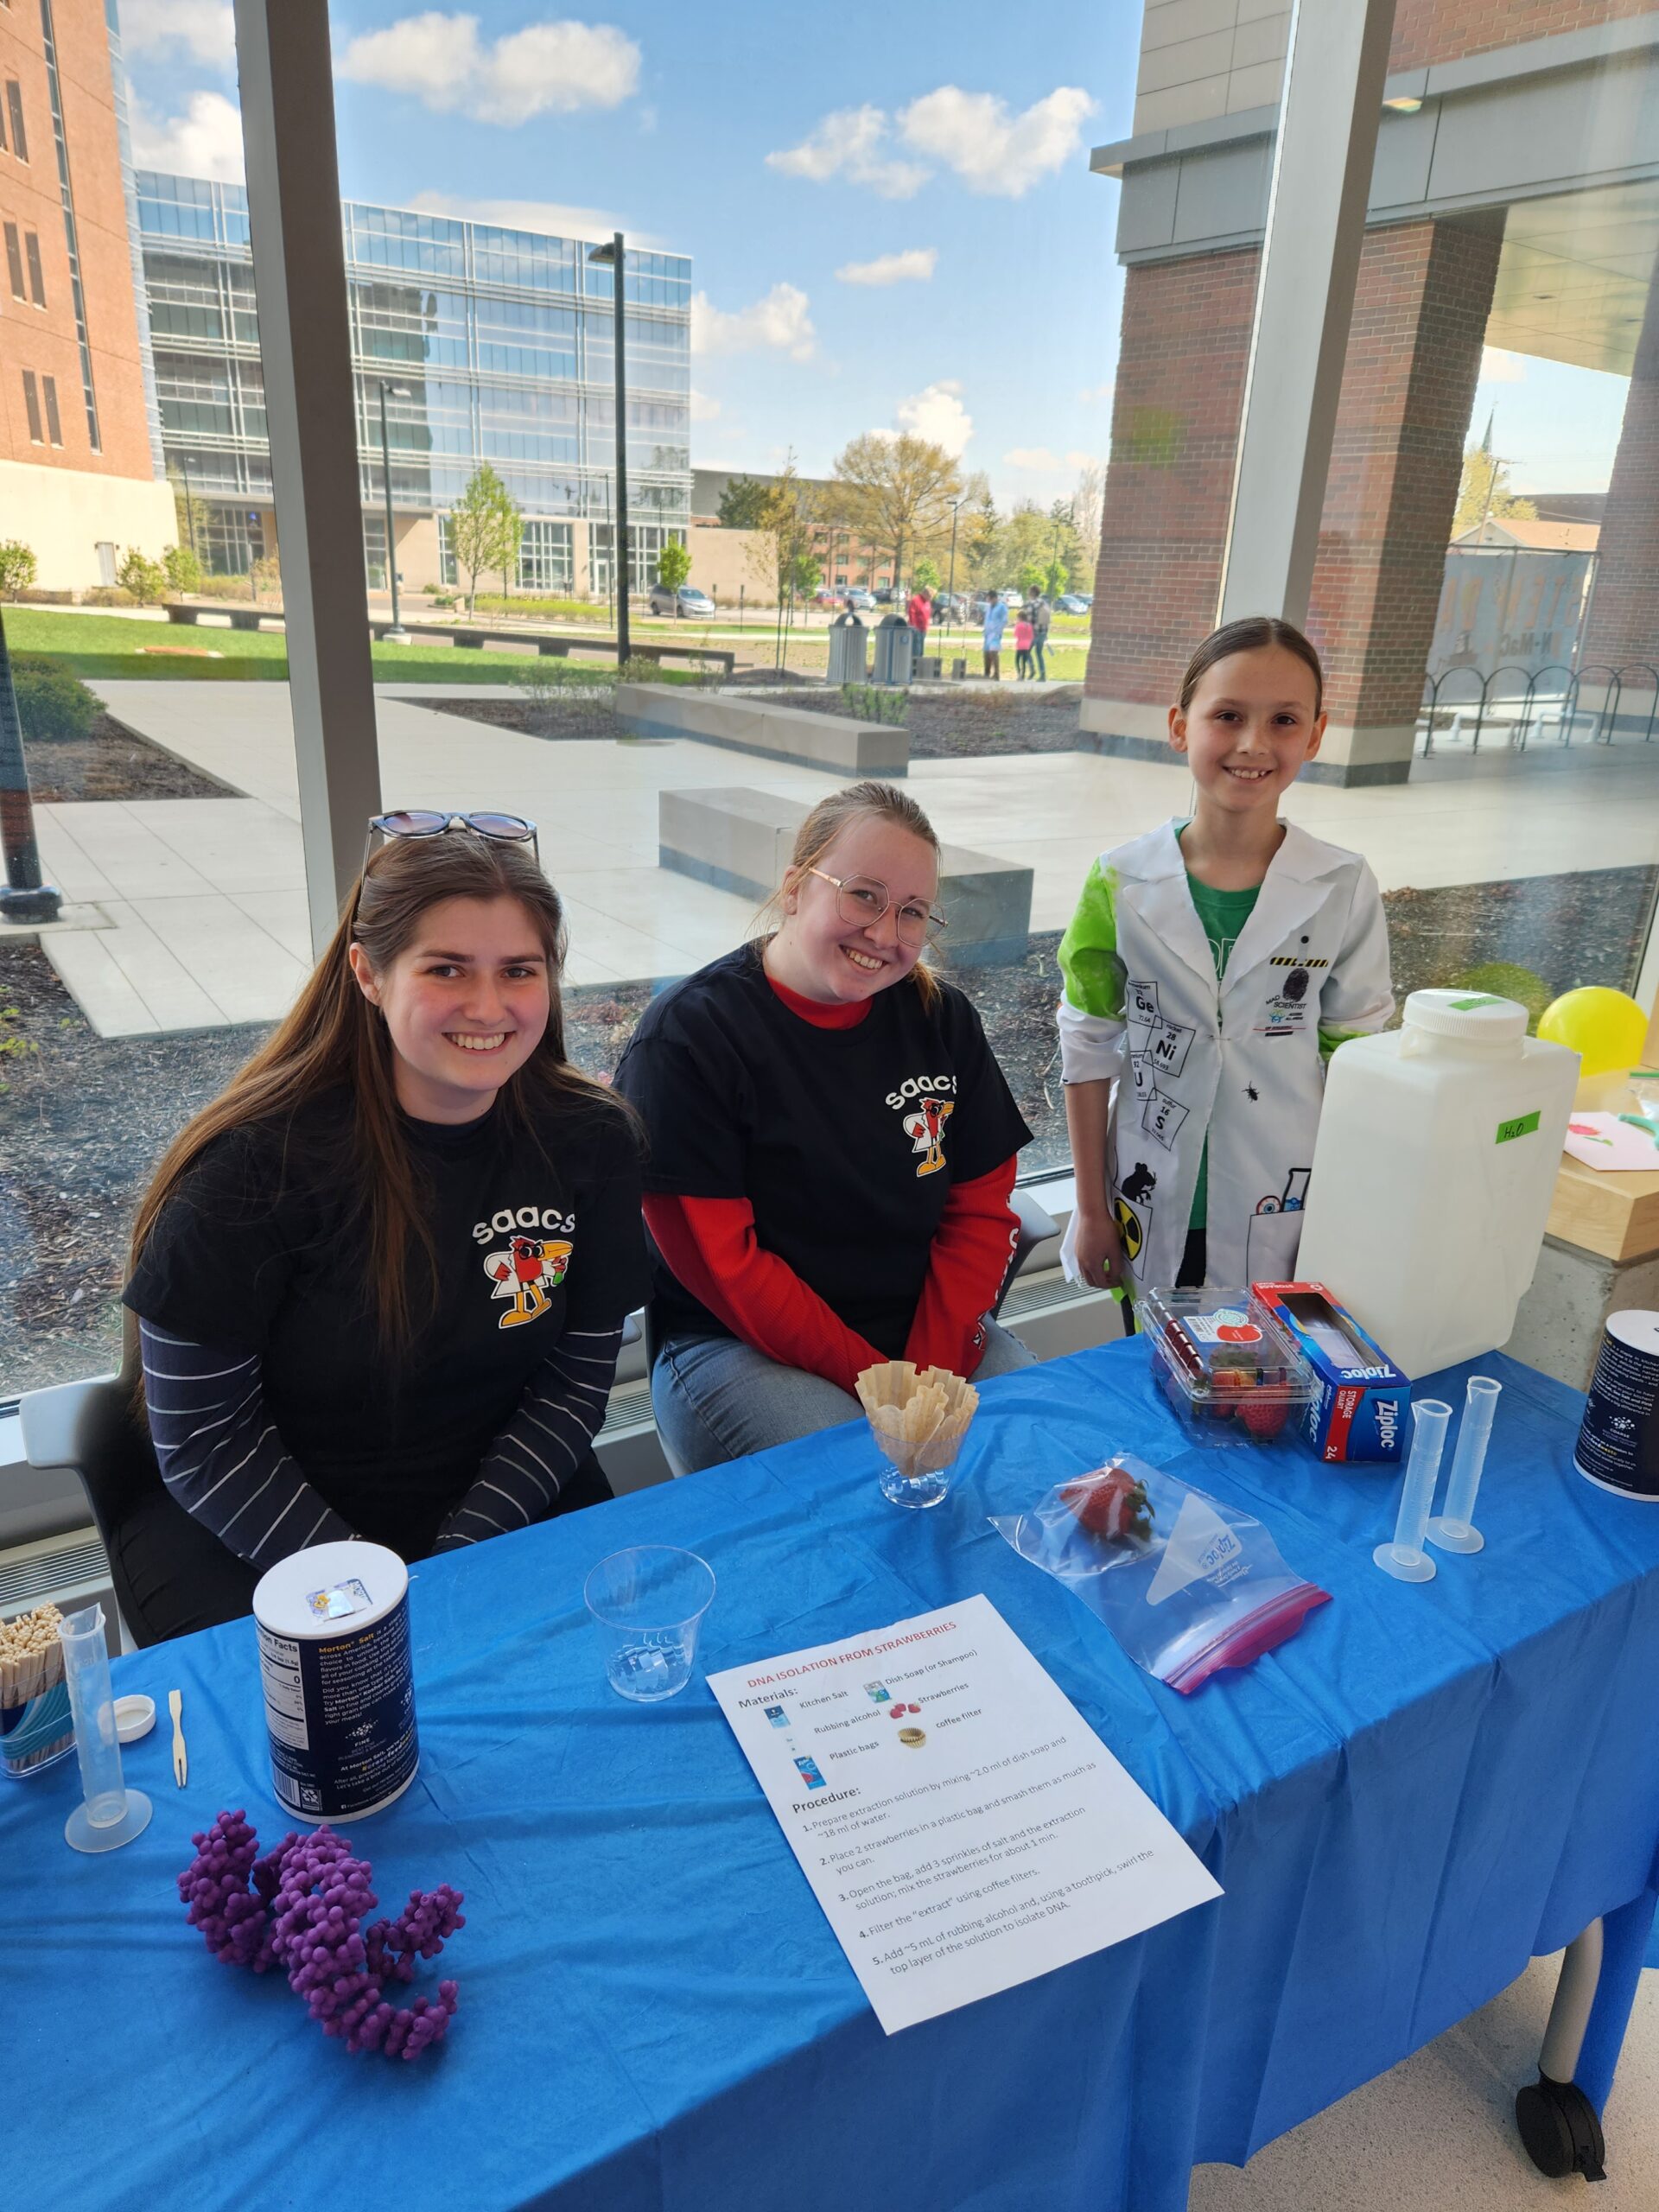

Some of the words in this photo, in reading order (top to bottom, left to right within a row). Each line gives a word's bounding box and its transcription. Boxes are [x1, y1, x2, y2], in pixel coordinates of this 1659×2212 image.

[1135, 996, 1154, 1013] Ge
[1266, 995, 1281, 1005] MAD
[1166, 1032, 1177, 1041] 28
[1155, 1039, 1177, 1060] Ni
[1134, 1071, 1143, 1087] U
[1160, 1106, 1170, 1116] 16
[1155, 1116, 1166, 1130] S
[1341, 1364, 1396, 1379] Ziploc
[1337, 1390, 1346, 1409] QUART
[1342, 1390, 1357, 1419] STORAGE
[1309, 1395, 1322, 1443] ploc
[1375, 1400, 1399, 1449] Ziploc
[1325, 1446, 1338, 1459] 24
[274, 1638, 298, 1653] Facts
[359, 1632, 375, 1643] Salt
[747, 1675, 775, 1688] DNA
[775, 1657, 838, 1681] ISOLATION
[838, 1648, 874, 1664] FROM
[874, 1622, 957, 1654] STRAWBERRIES
[885, 1675, 904, 1685] Dish
[903, 1669, 925, 1680] Soap
[924, 1663, 937, 1673] (or
[937, 1649, 978, 1668] Shampoo)
[294, 1675, 301, 1684] 0
[738, 1688, 798, 1708] Materials:
[798, 1695, 832, 1709] Kitchen
[831, 1690, 849, 1700] Salt
[918, 1683, 969, 1704] Strawberries
[813, 1720, 851, 1734] Rubbing
[850, 1709, 881, 1725] alcohol
[936, 1717, 962, 1728] coffee
[961, 1708, 982, 1720] filter
[829, 1748, 858, 1761] Plastic
[857, 1741, 880, 1752] bags
[802, 1824, 813, 1833] 1.
[811, 1814, 849, 1829] Prepare
[849, 1798, 893, 1819] extraction
[893, 1786, 930, 1802] solution
[928, 1783, 941, 1791] by
[942, 1773, 971, 1787] mixing
[969, 1765, 989, 1777] ~2.0
[989, 1761, 1002, 1770] ml
[1001, 1757, 1012, 1767] of
[1012, 1751, 1030, 1763] dish
[1029, 1744, 1050, 1756] soap
[1050, 1736, 1067, 1748] and
[791, 1788, 861, 1814] Procedure:
[818, 1857, 830, 1866] 2.
[829, 1849, 855, 1863] Place
[855, 1846, 863, 1854] 2
[863, 1827, 920, 1852] strawberries
[918, 1823, 931, 1832] in
[938, 1811, 967, 1827] plastic
[964, 1806, 984, 1816] bag
[983, 1798, 1001, 1811] and
[1001, 1789, 1029, 1805] smash
[1027, 1781, 1052, 1795] them
[1051, 1777, 1063, 1785] as
[1062, 1766, 1086, 1781] much
[1085, 1762, 1096, 1770] as
[817, 1828, 836, 1839] ~18
[836, 1824, 849, 1834] ml
[850, 1820, 861, 1831] of
[860, 1812, 891, 1827] water.
[837, 1893, 849, 1903] 3.
[849, 1885, 876, 1899] Open
[875, 1878, 893, 1889] the
[892, 1872, 914, 1883] bag,
[914, 1861, 933, 1875] add
[931, 1859, 941, 1868] 3
[941, 1847, 982, 1866] sprinkles
[981, 1840, 992, 1852] of
[992, 1836, 1010, 1848] salt
[1008, 1829, 1027, 1842] and
[1026, 1825, 1043, 1835] the
[1043, 1807, 1086, 1829] extraction
[836, 1863, 855, 1876] you
[855, 1857, 875, 1868] can.
[855, 1891, 898, 1910] solution;
[897, 1884, 916, 1895] mix
[915, 1878, 933, 1888] the
[932, 1857, 989, 1882] strawberries
[988, 1852, 1003, 1862] for
[1003, 1841, 1032, 1857] about
[1030, 1839, 1039, 1847] 1
[1038, 1833, 1059, 1844] min.
[859, 1930, 870, 1939] 4.
[868, 1921, 893, 1936] Filter
[894, 1915, 912, 1926] the
[956, 1889, 982, 1904] using
[982, 1878, 1011, 1894] coffee
[1010, 1869, 1040, 1883] filters.
[871, 1956, 884, 1966] 5.
[884, 1946, 905, 1962] Add
[904, 1942, 918, 1952] ~5
[918, 1936, 936, 1948] mL
[935, 1930, 947, 1942] of
[946, 1919, 985, 1938] rubbing
[983, 1904, 1019, 1924] alcohol
[1018, 1897, 1040, 1910] and,
[1039, 1888, 1065, 1903] using
[1071, 1867, 1117, 1890] toothpick,
[1116, 1855, 1138, 1872] swirl
[1136, 1850, 1154, 1861] the
[889, 1962, 909, 1975] top
[907, 1953, 933, 1967] layer
[934, 1946, 946, 1958] of
[945, 1942, 964, 1954] the
[963, 1927, 1004, 1948] solution
[1002, 1923, 1015, 1932] to
[1014, 1910, 1047, 1928] isolate
[1045, 1901, 1071, 1915] DNA.
